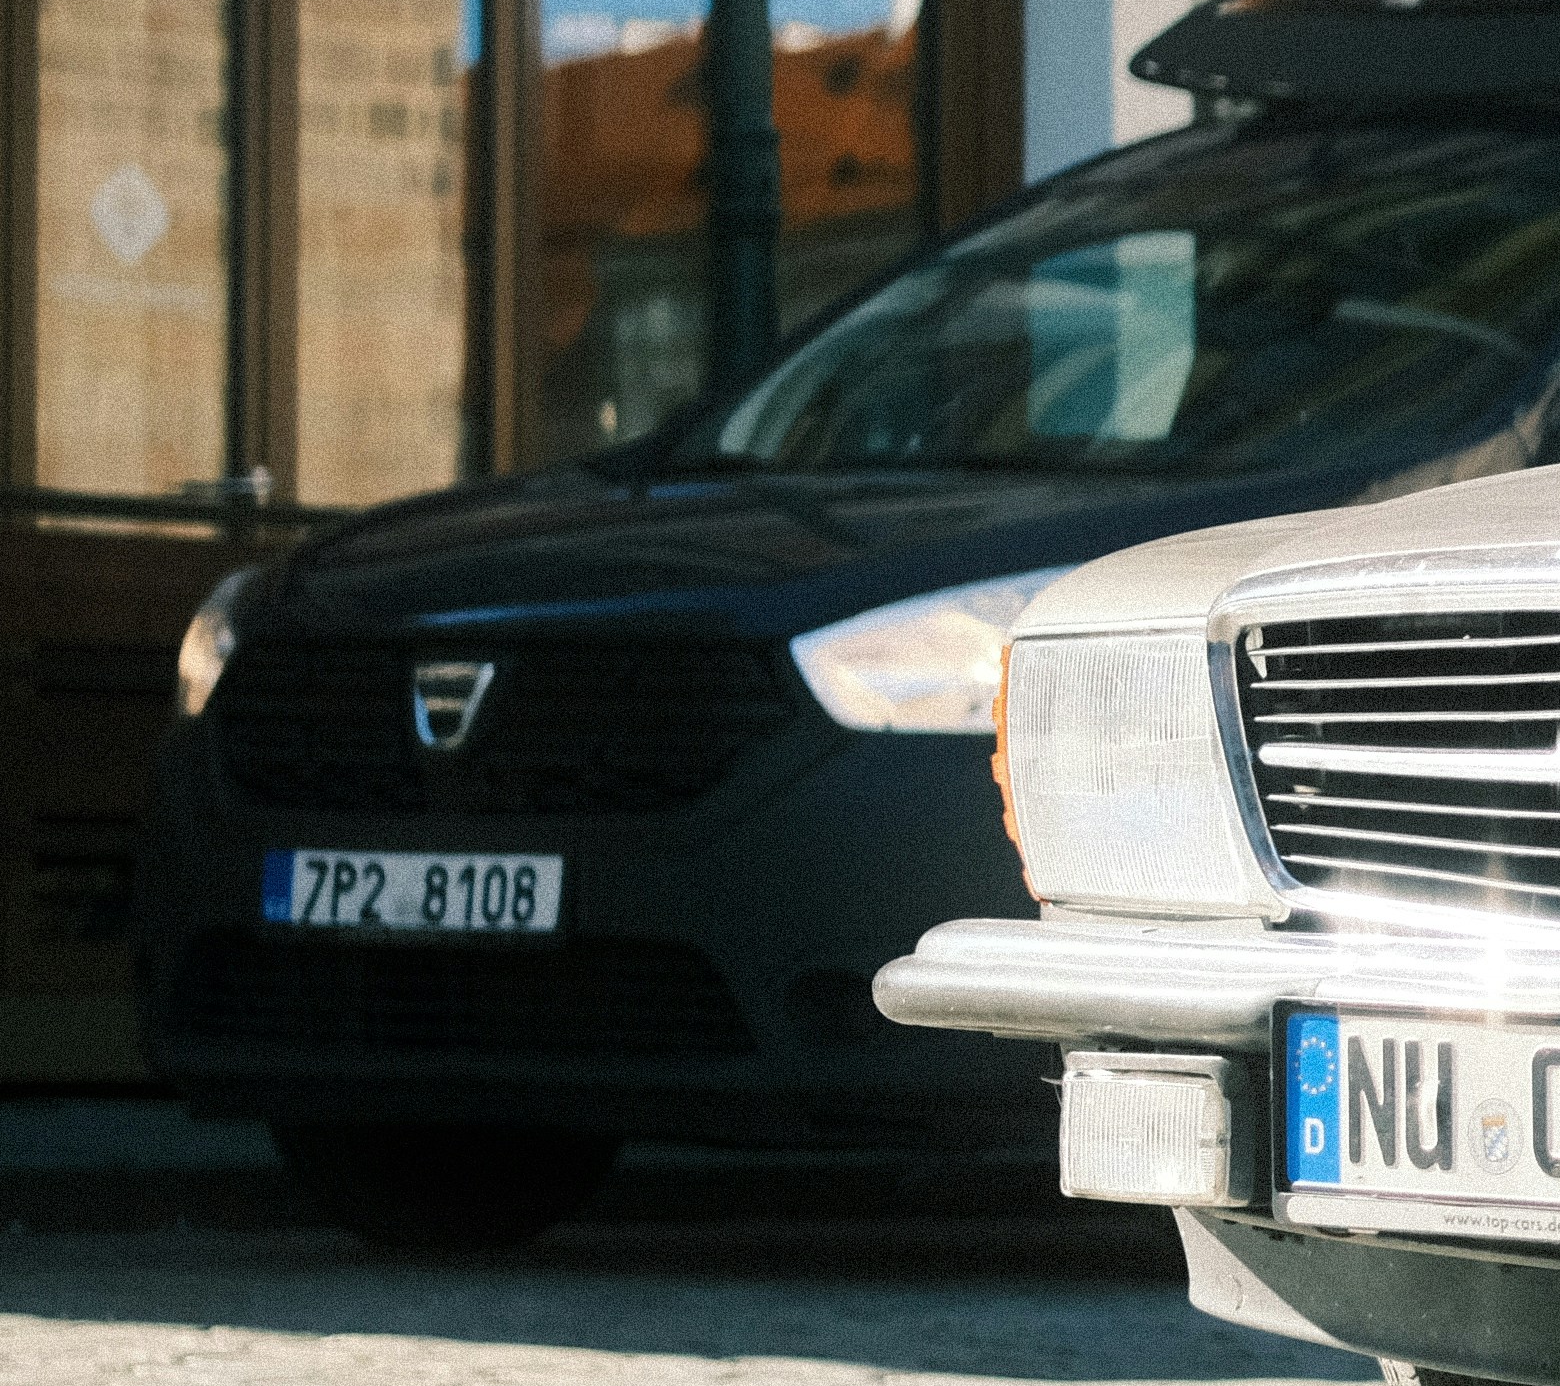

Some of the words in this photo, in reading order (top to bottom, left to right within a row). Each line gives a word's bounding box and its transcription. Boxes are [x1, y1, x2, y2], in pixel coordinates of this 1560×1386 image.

[304, 858, 386, 923] 7P2
[420, 863, 538, 925] 8108
[1303, 1117, 1326, 1154] D
[1346, 1035, 1454, 1171] NU
